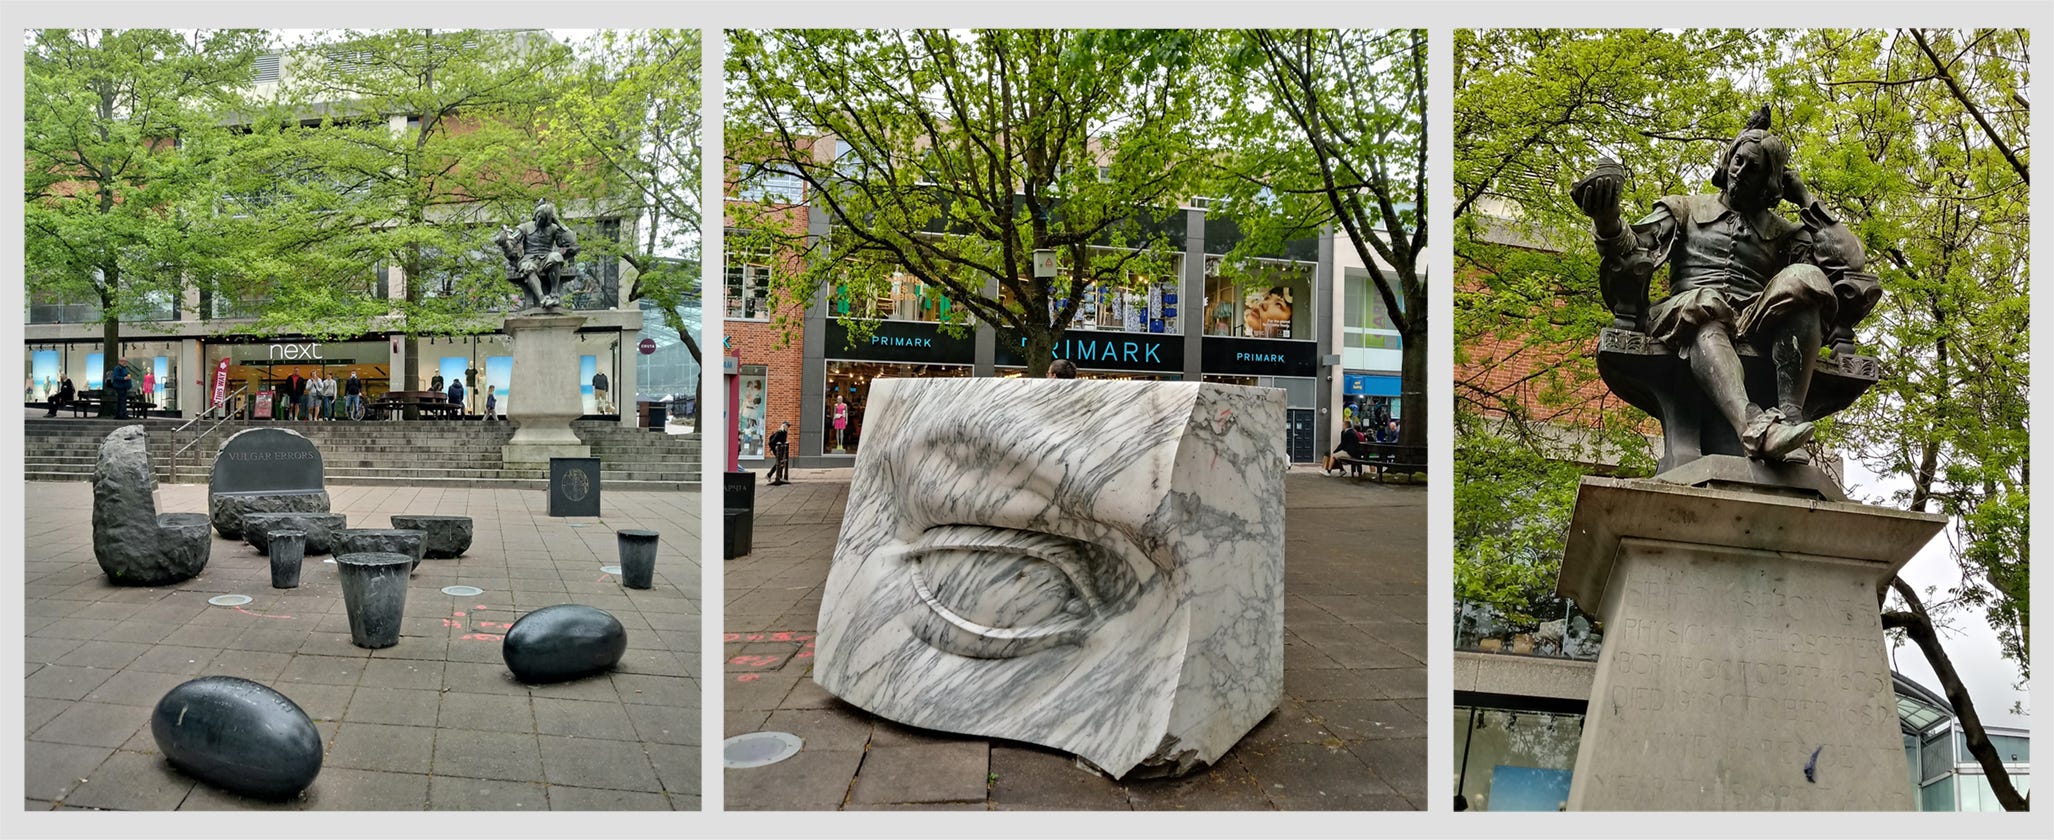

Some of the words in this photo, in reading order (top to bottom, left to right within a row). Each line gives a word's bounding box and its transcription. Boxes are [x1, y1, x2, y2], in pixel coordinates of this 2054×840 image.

[872, 336, 932, 348] PRIMARK
[270, 343, 323, 360] next
[1237, 352, 1285, 363] PRIMARK
[218, 372, 226, 387] WAY
[228, 452, 272, 461] VULGAR
[274, 450, 314, 461] ERRORS
[1697, 657, 1820, 688] OCTOBER
[1612, 685, 1665, 712] DIED
